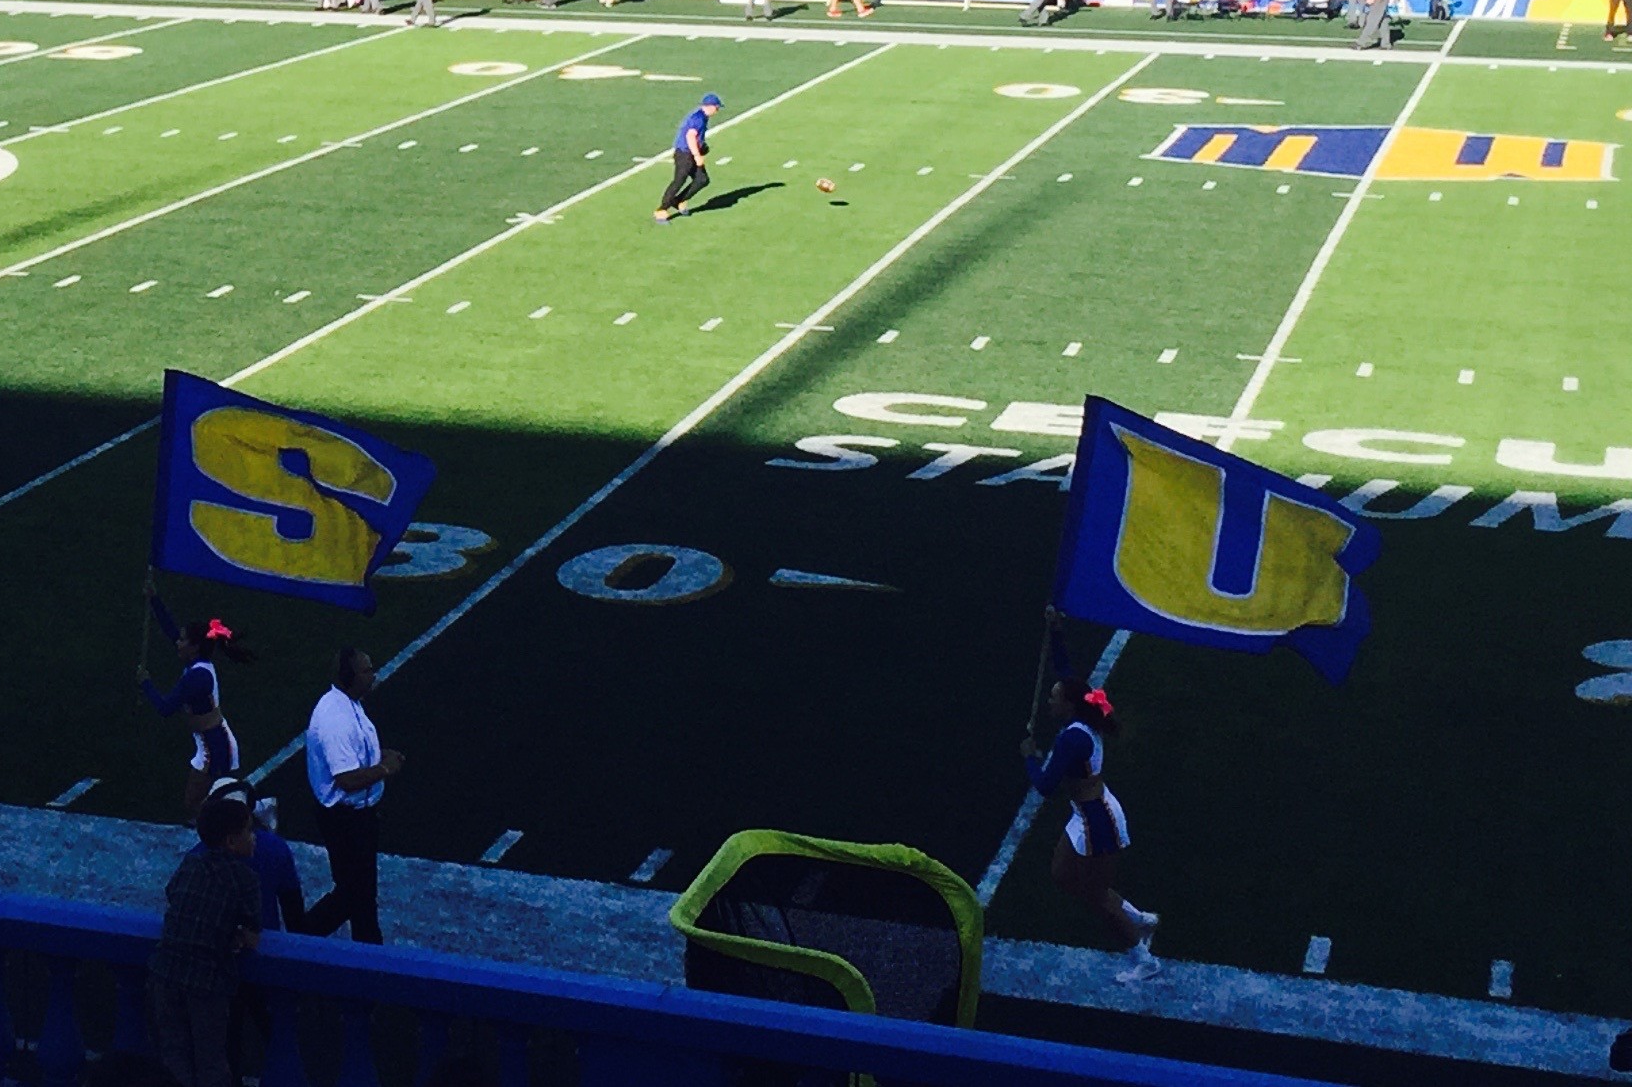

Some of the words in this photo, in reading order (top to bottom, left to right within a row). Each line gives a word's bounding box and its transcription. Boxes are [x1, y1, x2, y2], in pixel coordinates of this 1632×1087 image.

[188, 405, 398, 587] S
[765, 435, 1632, 539] STAUM
[1109, 420, 1357, 635] U
